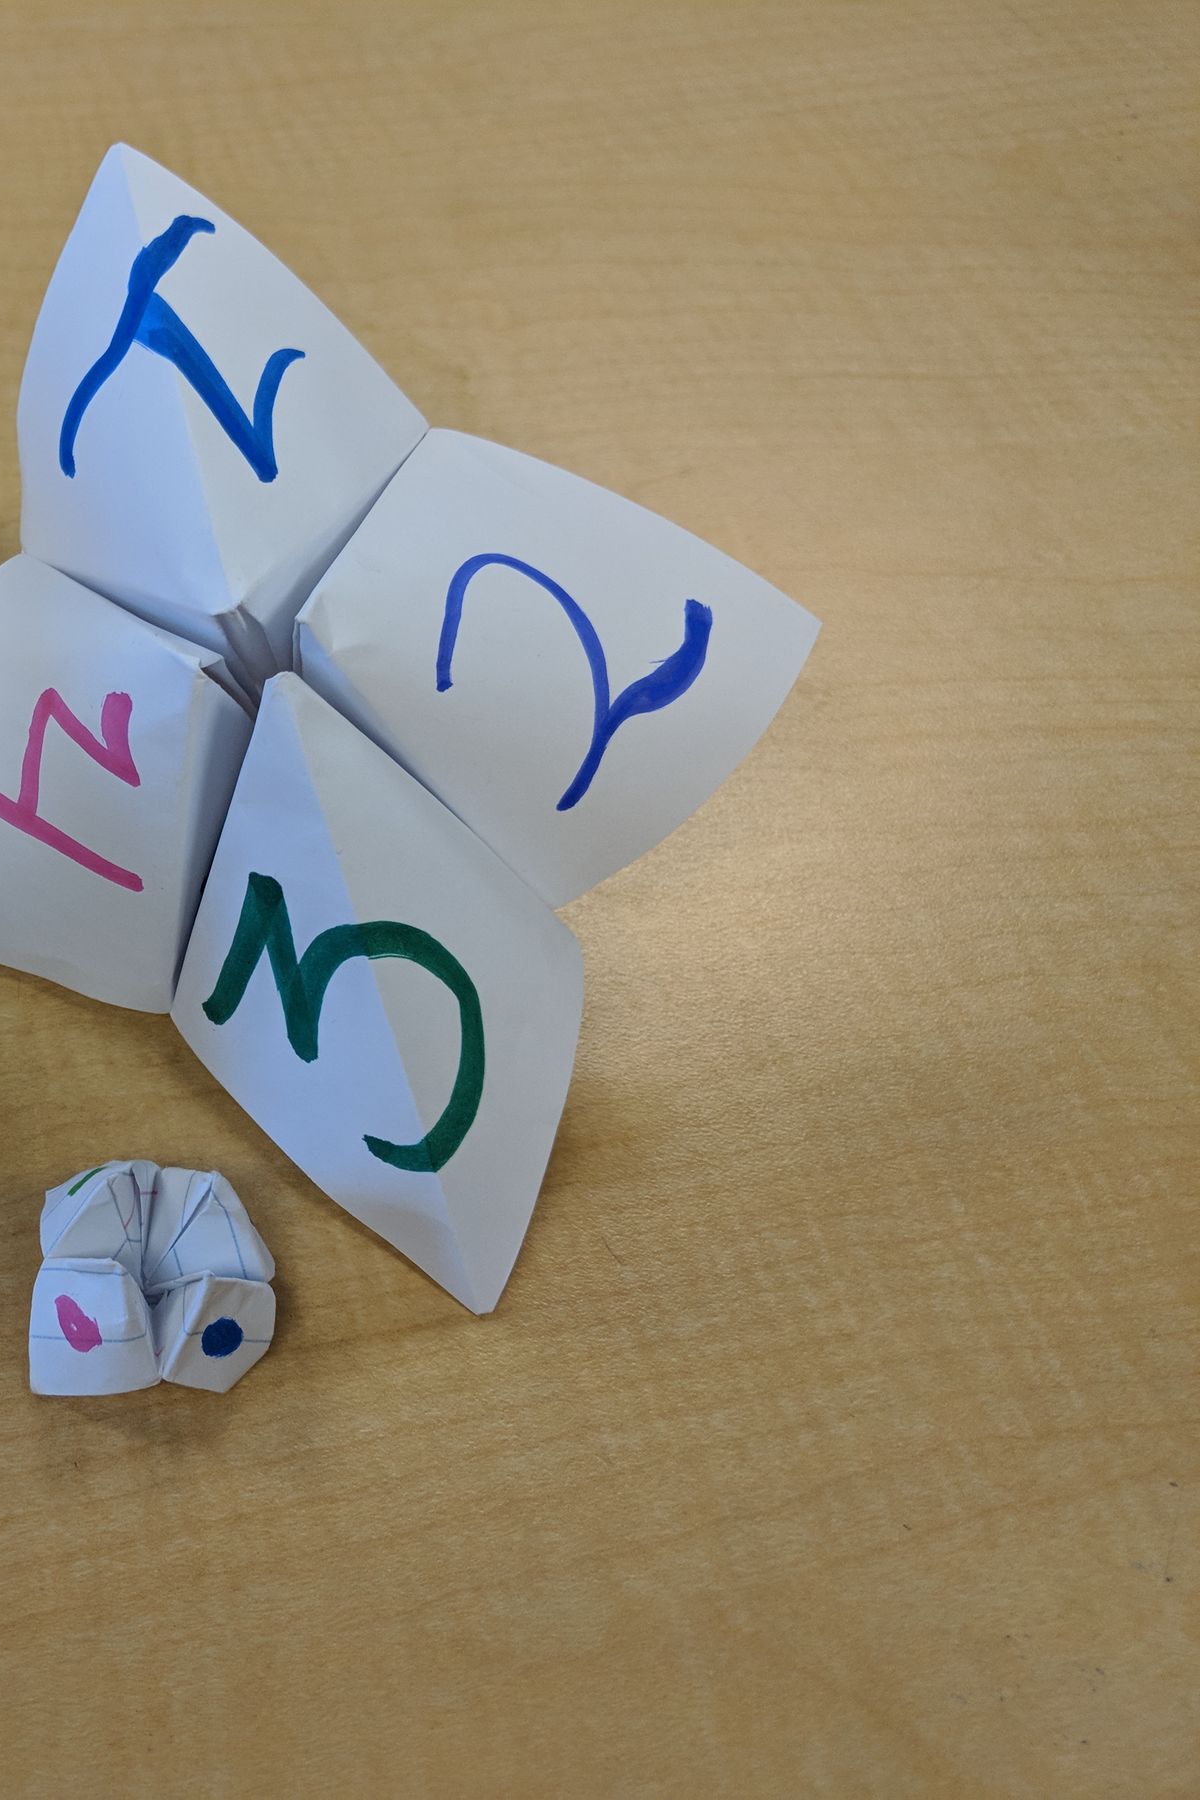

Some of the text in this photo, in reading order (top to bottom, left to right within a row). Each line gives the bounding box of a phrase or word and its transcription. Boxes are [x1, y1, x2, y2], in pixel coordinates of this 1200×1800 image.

[59, 214, 306, 484] 1
[436, 553, 713, 812] 2
[202, 871, 485, 1174] 3
